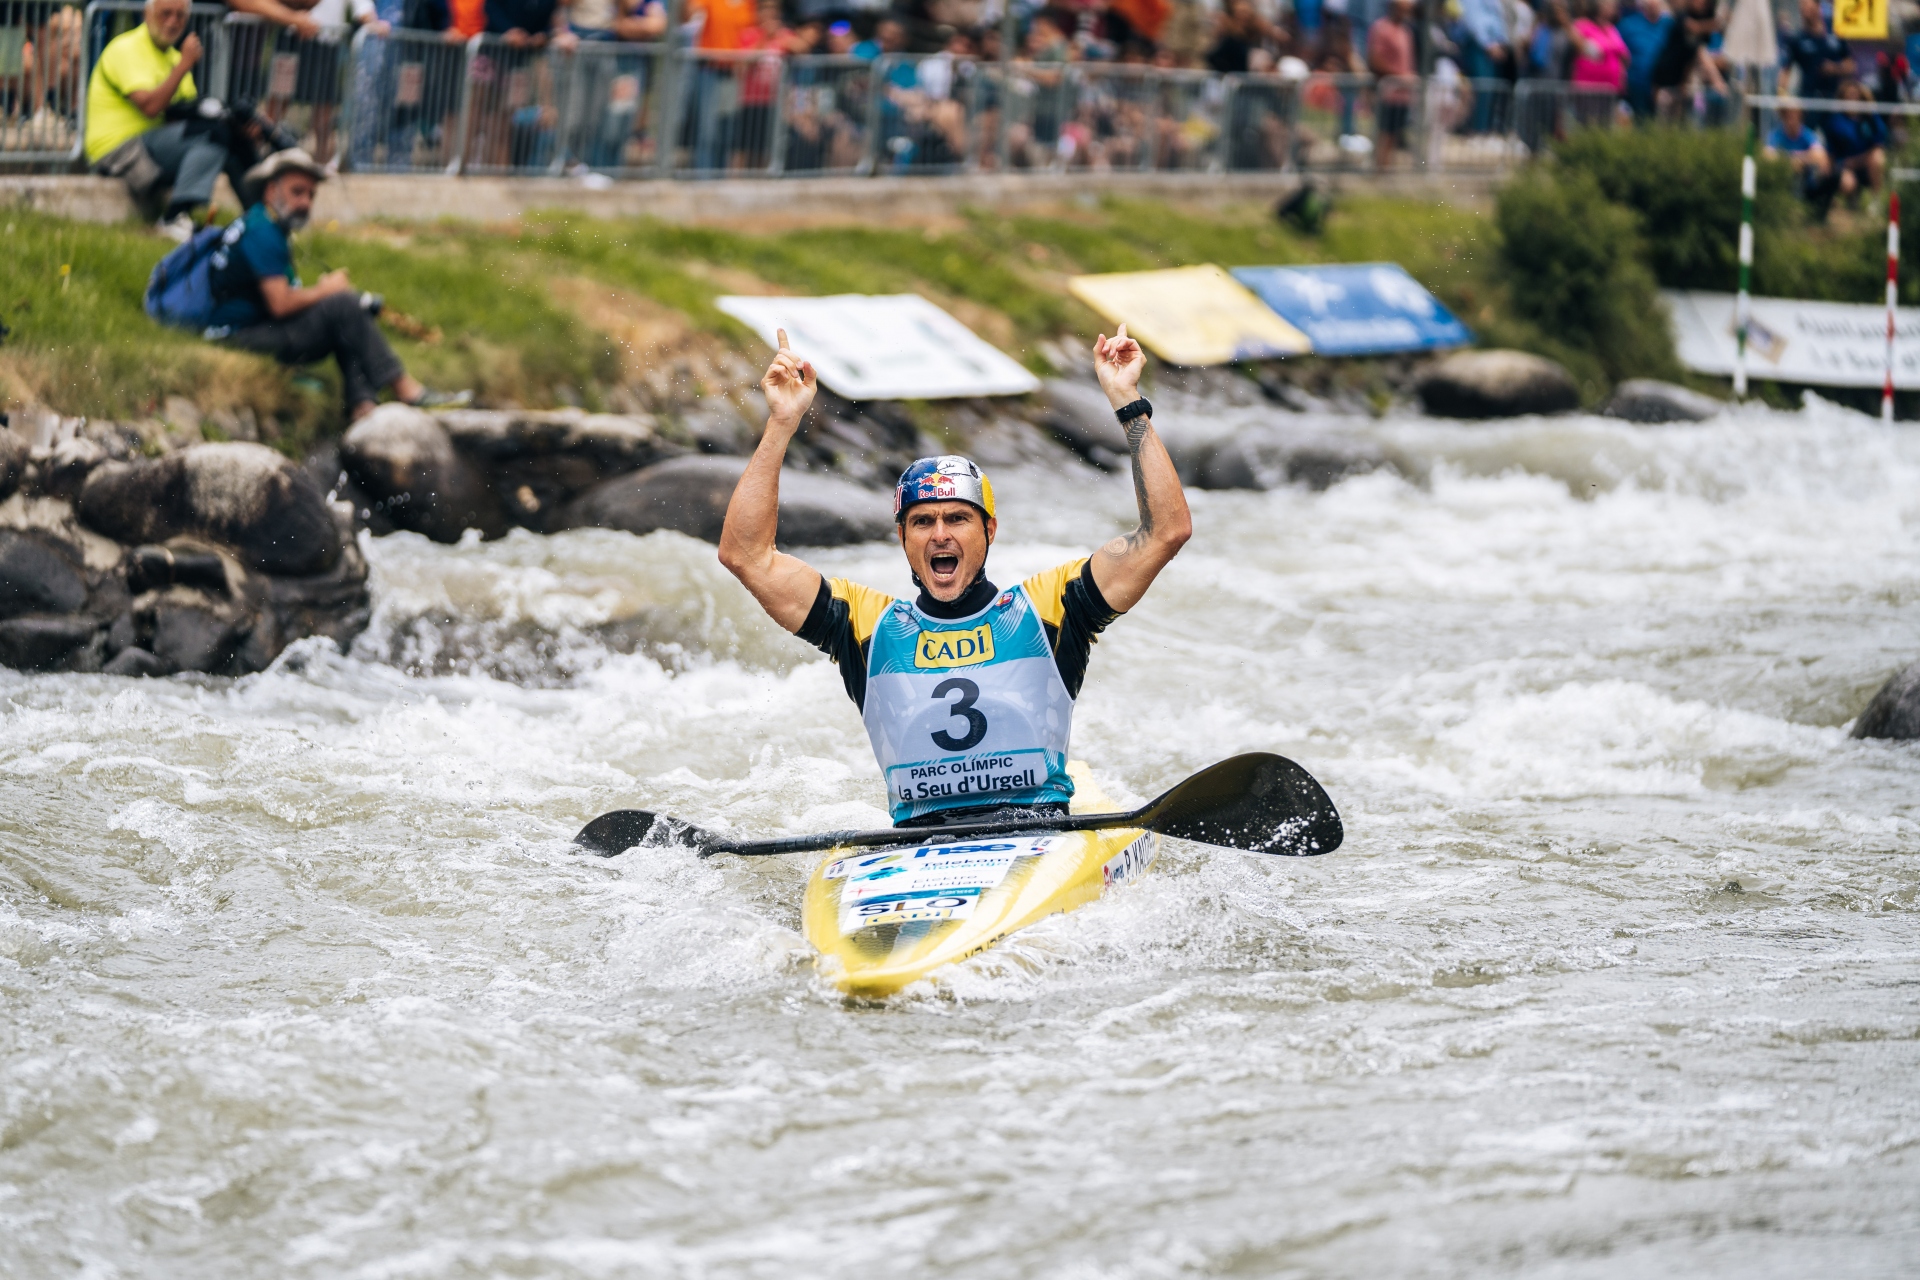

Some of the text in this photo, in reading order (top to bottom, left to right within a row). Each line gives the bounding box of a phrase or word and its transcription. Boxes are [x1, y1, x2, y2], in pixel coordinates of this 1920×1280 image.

[918, 487, 956, 499] Red Bull
[930, 677, 988, 752] 3
[911, 757, 1013, 779] PARC OLÍMPIC
[917, 782, 952, 799] Seu
[957, 769, 1037, 793] d'Urgell
[914, 843, 1017, 858] hse
[921, 858, 1009, 867] Telekom
[911, 879, 994, 889] Ljubljana
[913, 874, 978, 884] Elektro
[858, 897, 968, 917] SLO
